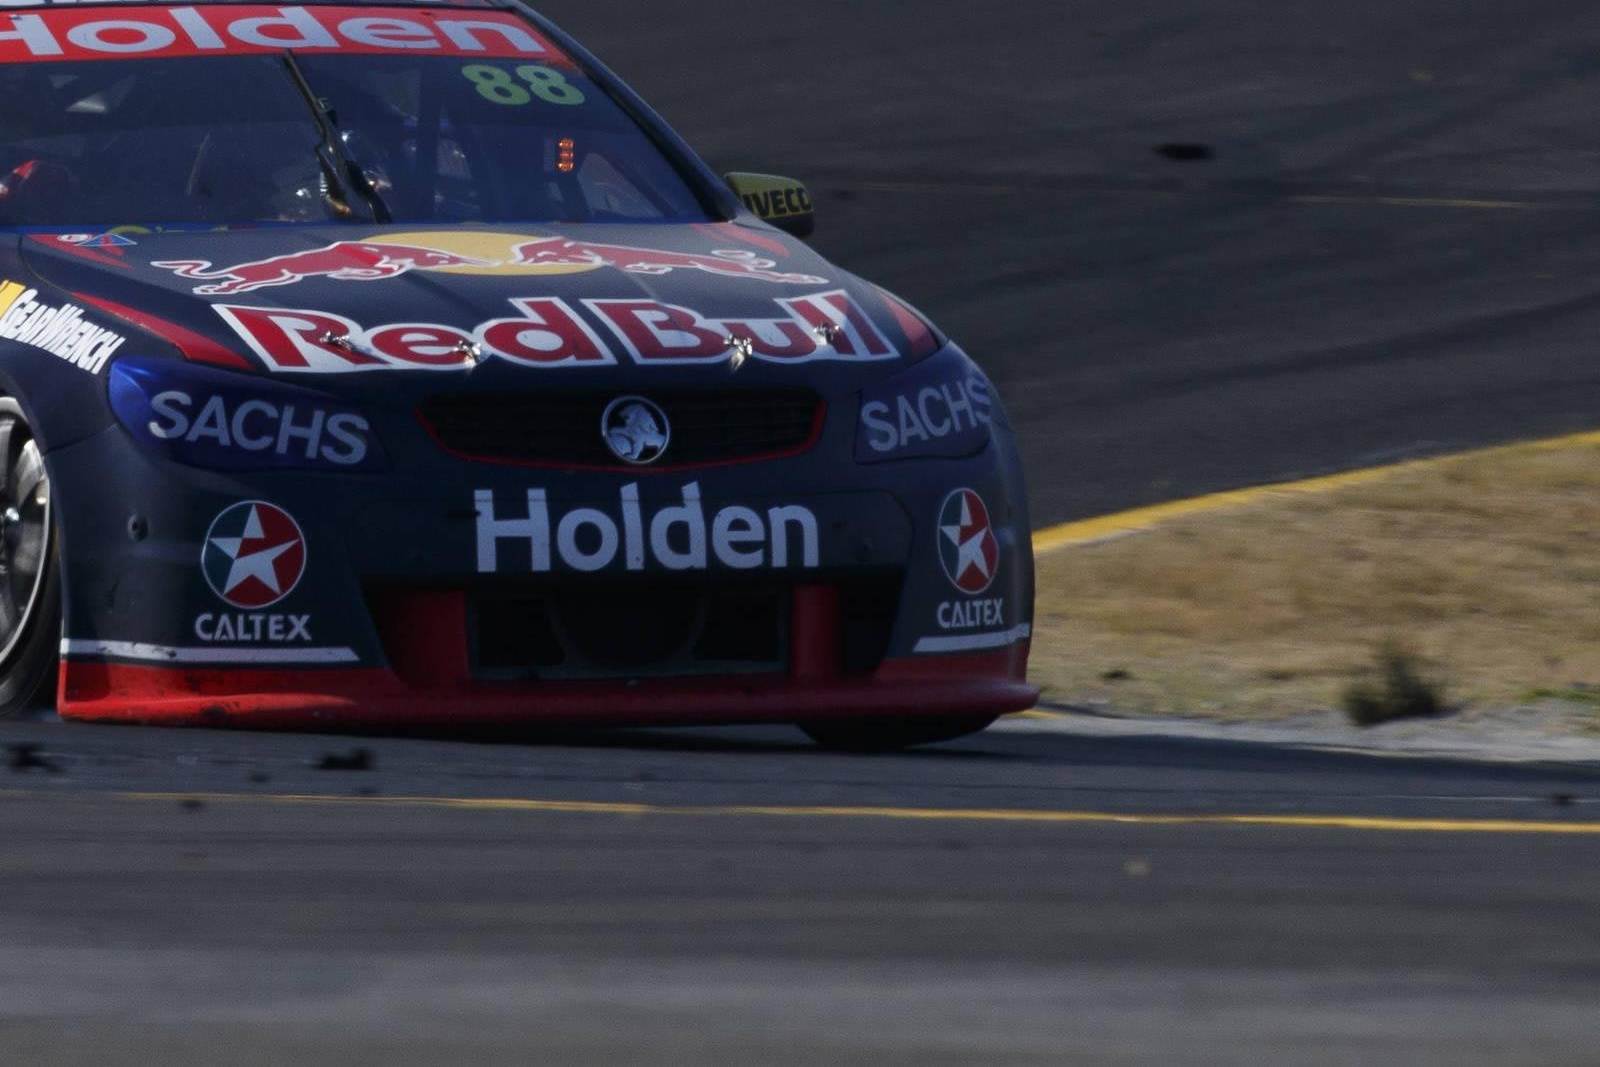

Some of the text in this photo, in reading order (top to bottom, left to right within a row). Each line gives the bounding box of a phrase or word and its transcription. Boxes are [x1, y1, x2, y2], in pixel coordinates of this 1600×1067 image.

[462, 64, 585, 105] 88
[212, 290, 901, 372] Red Bull
[149, 390, 370, 465] SACHS
[860, 376, 992, 452] SACHS
[473, 481, 821, 573] Holden
[195, 613, 312, 641] CALTEX
[936, 597, 1004, 629] CALTEX
